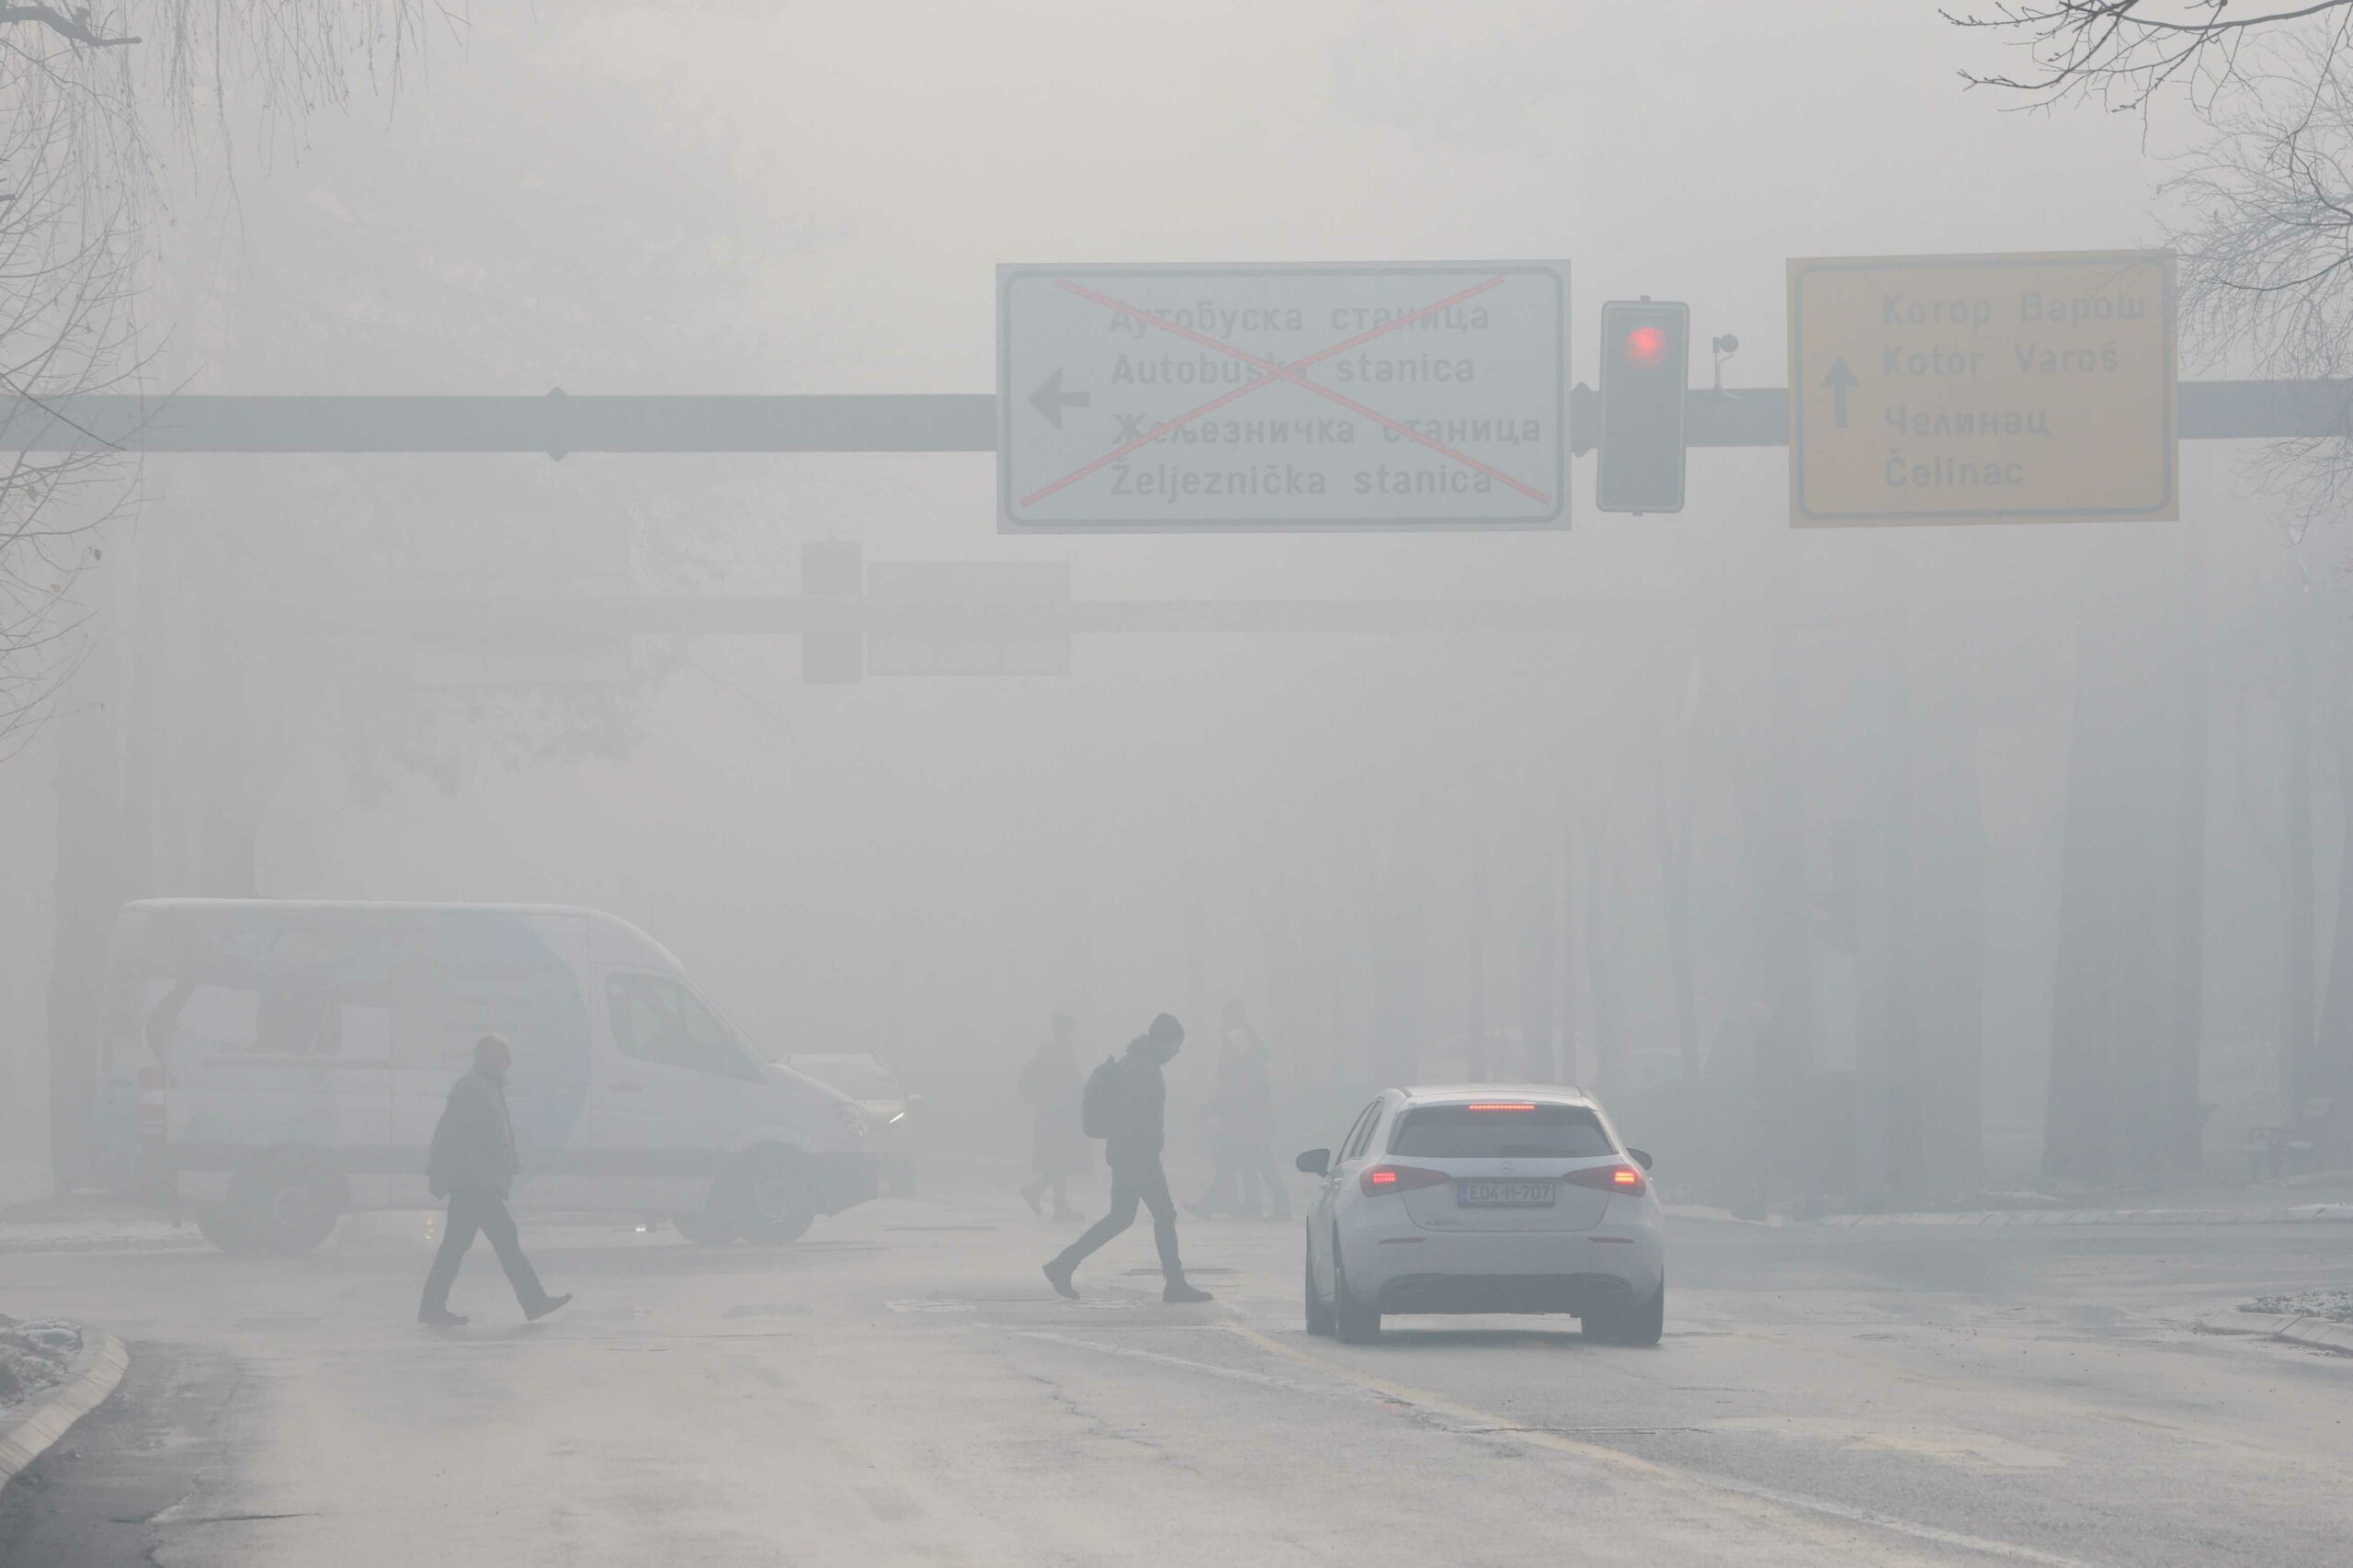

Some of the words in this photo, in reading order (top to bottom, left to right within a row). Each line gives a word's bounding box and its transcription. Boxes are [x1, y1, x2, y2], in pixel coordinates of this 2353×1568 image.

[1110, 301, 1303, 339] Аутобуска
[1332, 303, 1490, 334] станица
[1882, 294, 1993, 332] Котор
[2019, 290, 2145, 328] Варош
[1336, 352, 1475, 382] stanica
[1882, 346, 1984, 377] Kotor
[1111, 412, 1356, 445] Жељезничка
[1384, 417, 1542, 446] станица
[1883, 406, 2051, 437] Челинац
[1111, 456, 1327, 503] Željeznička
[1354, 464, 1492, 494] stanica
[1884, 448, 2023, 487] Čelinac
